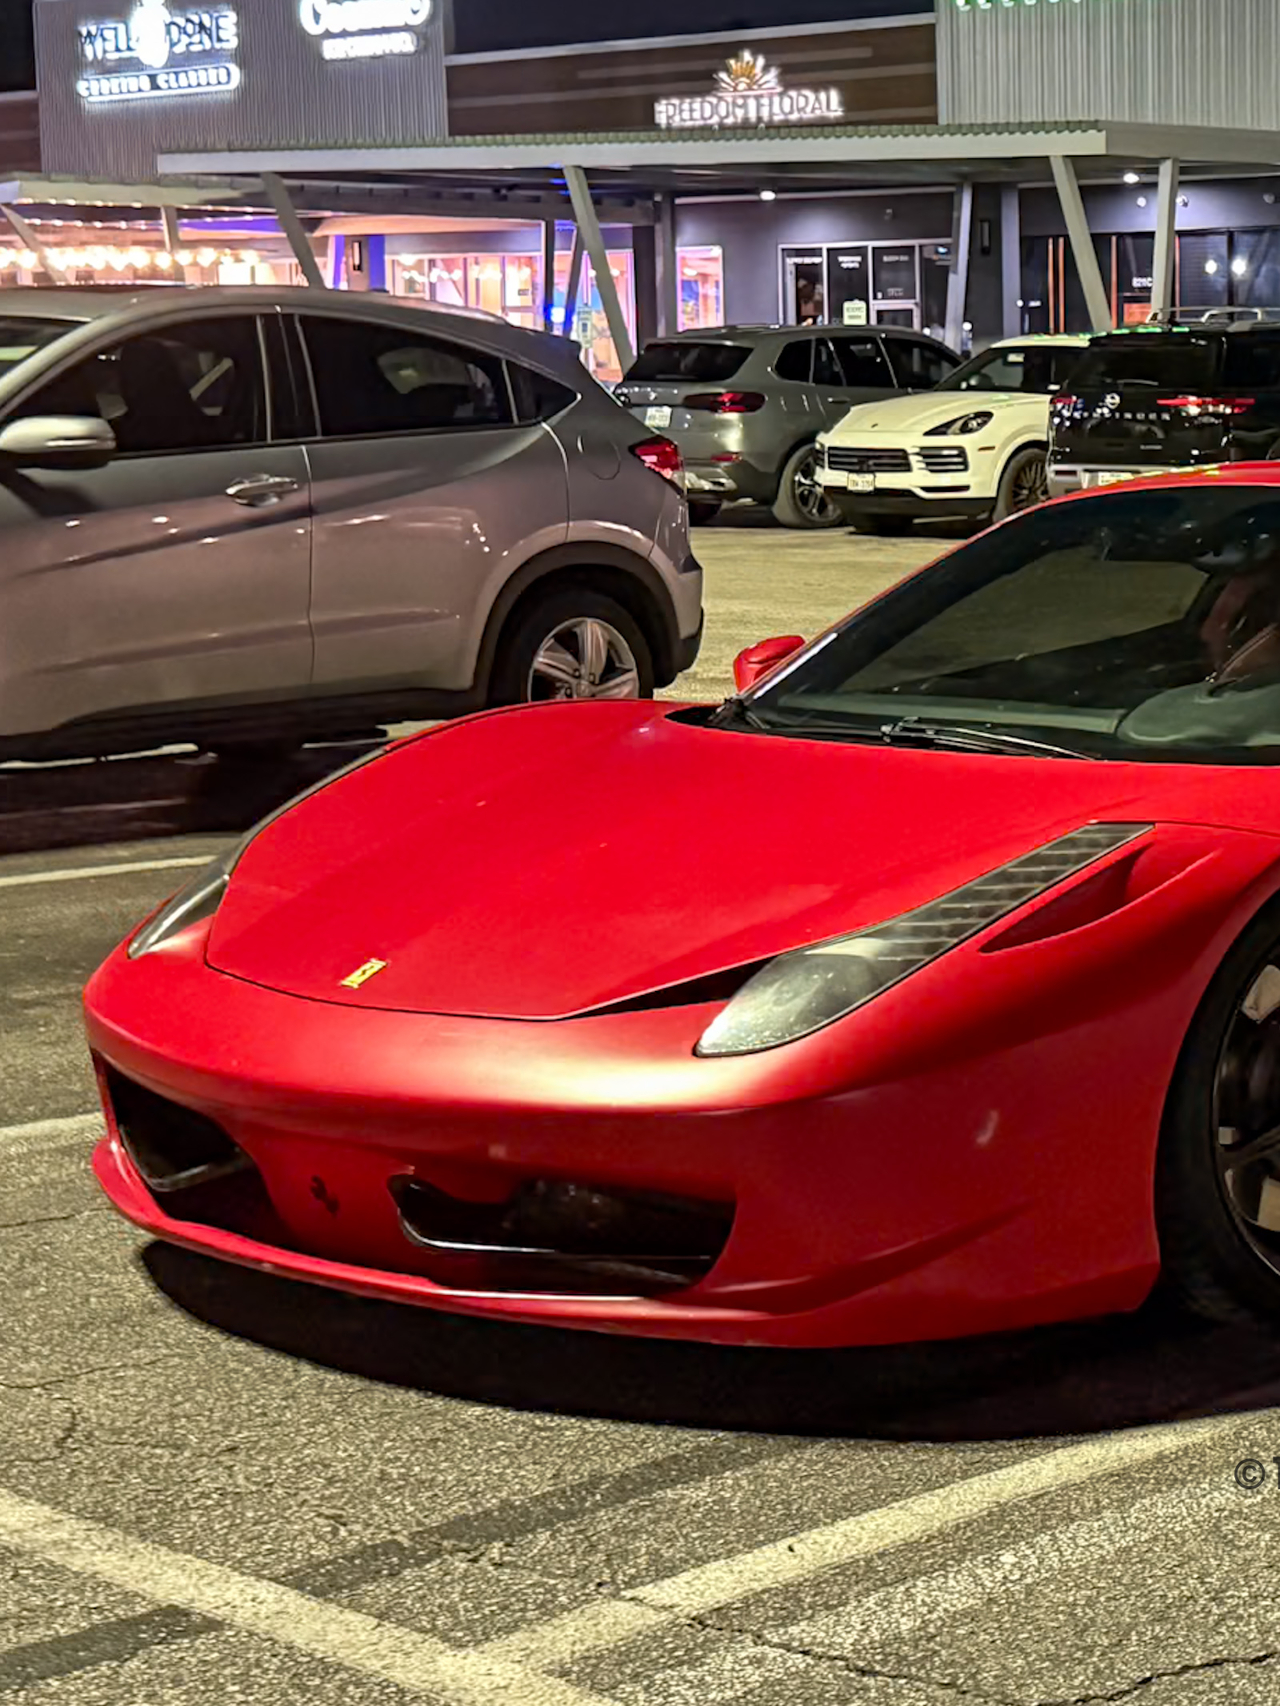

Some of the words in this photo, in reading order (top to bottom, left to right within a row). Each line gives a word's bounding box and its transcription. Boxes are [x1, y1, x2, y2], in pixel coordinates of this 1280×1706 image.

[164, 11, 239, 54] DONE
[653, 95, 754, 128] FREEDOM
[755, 87, 845, 122] FLORAL
